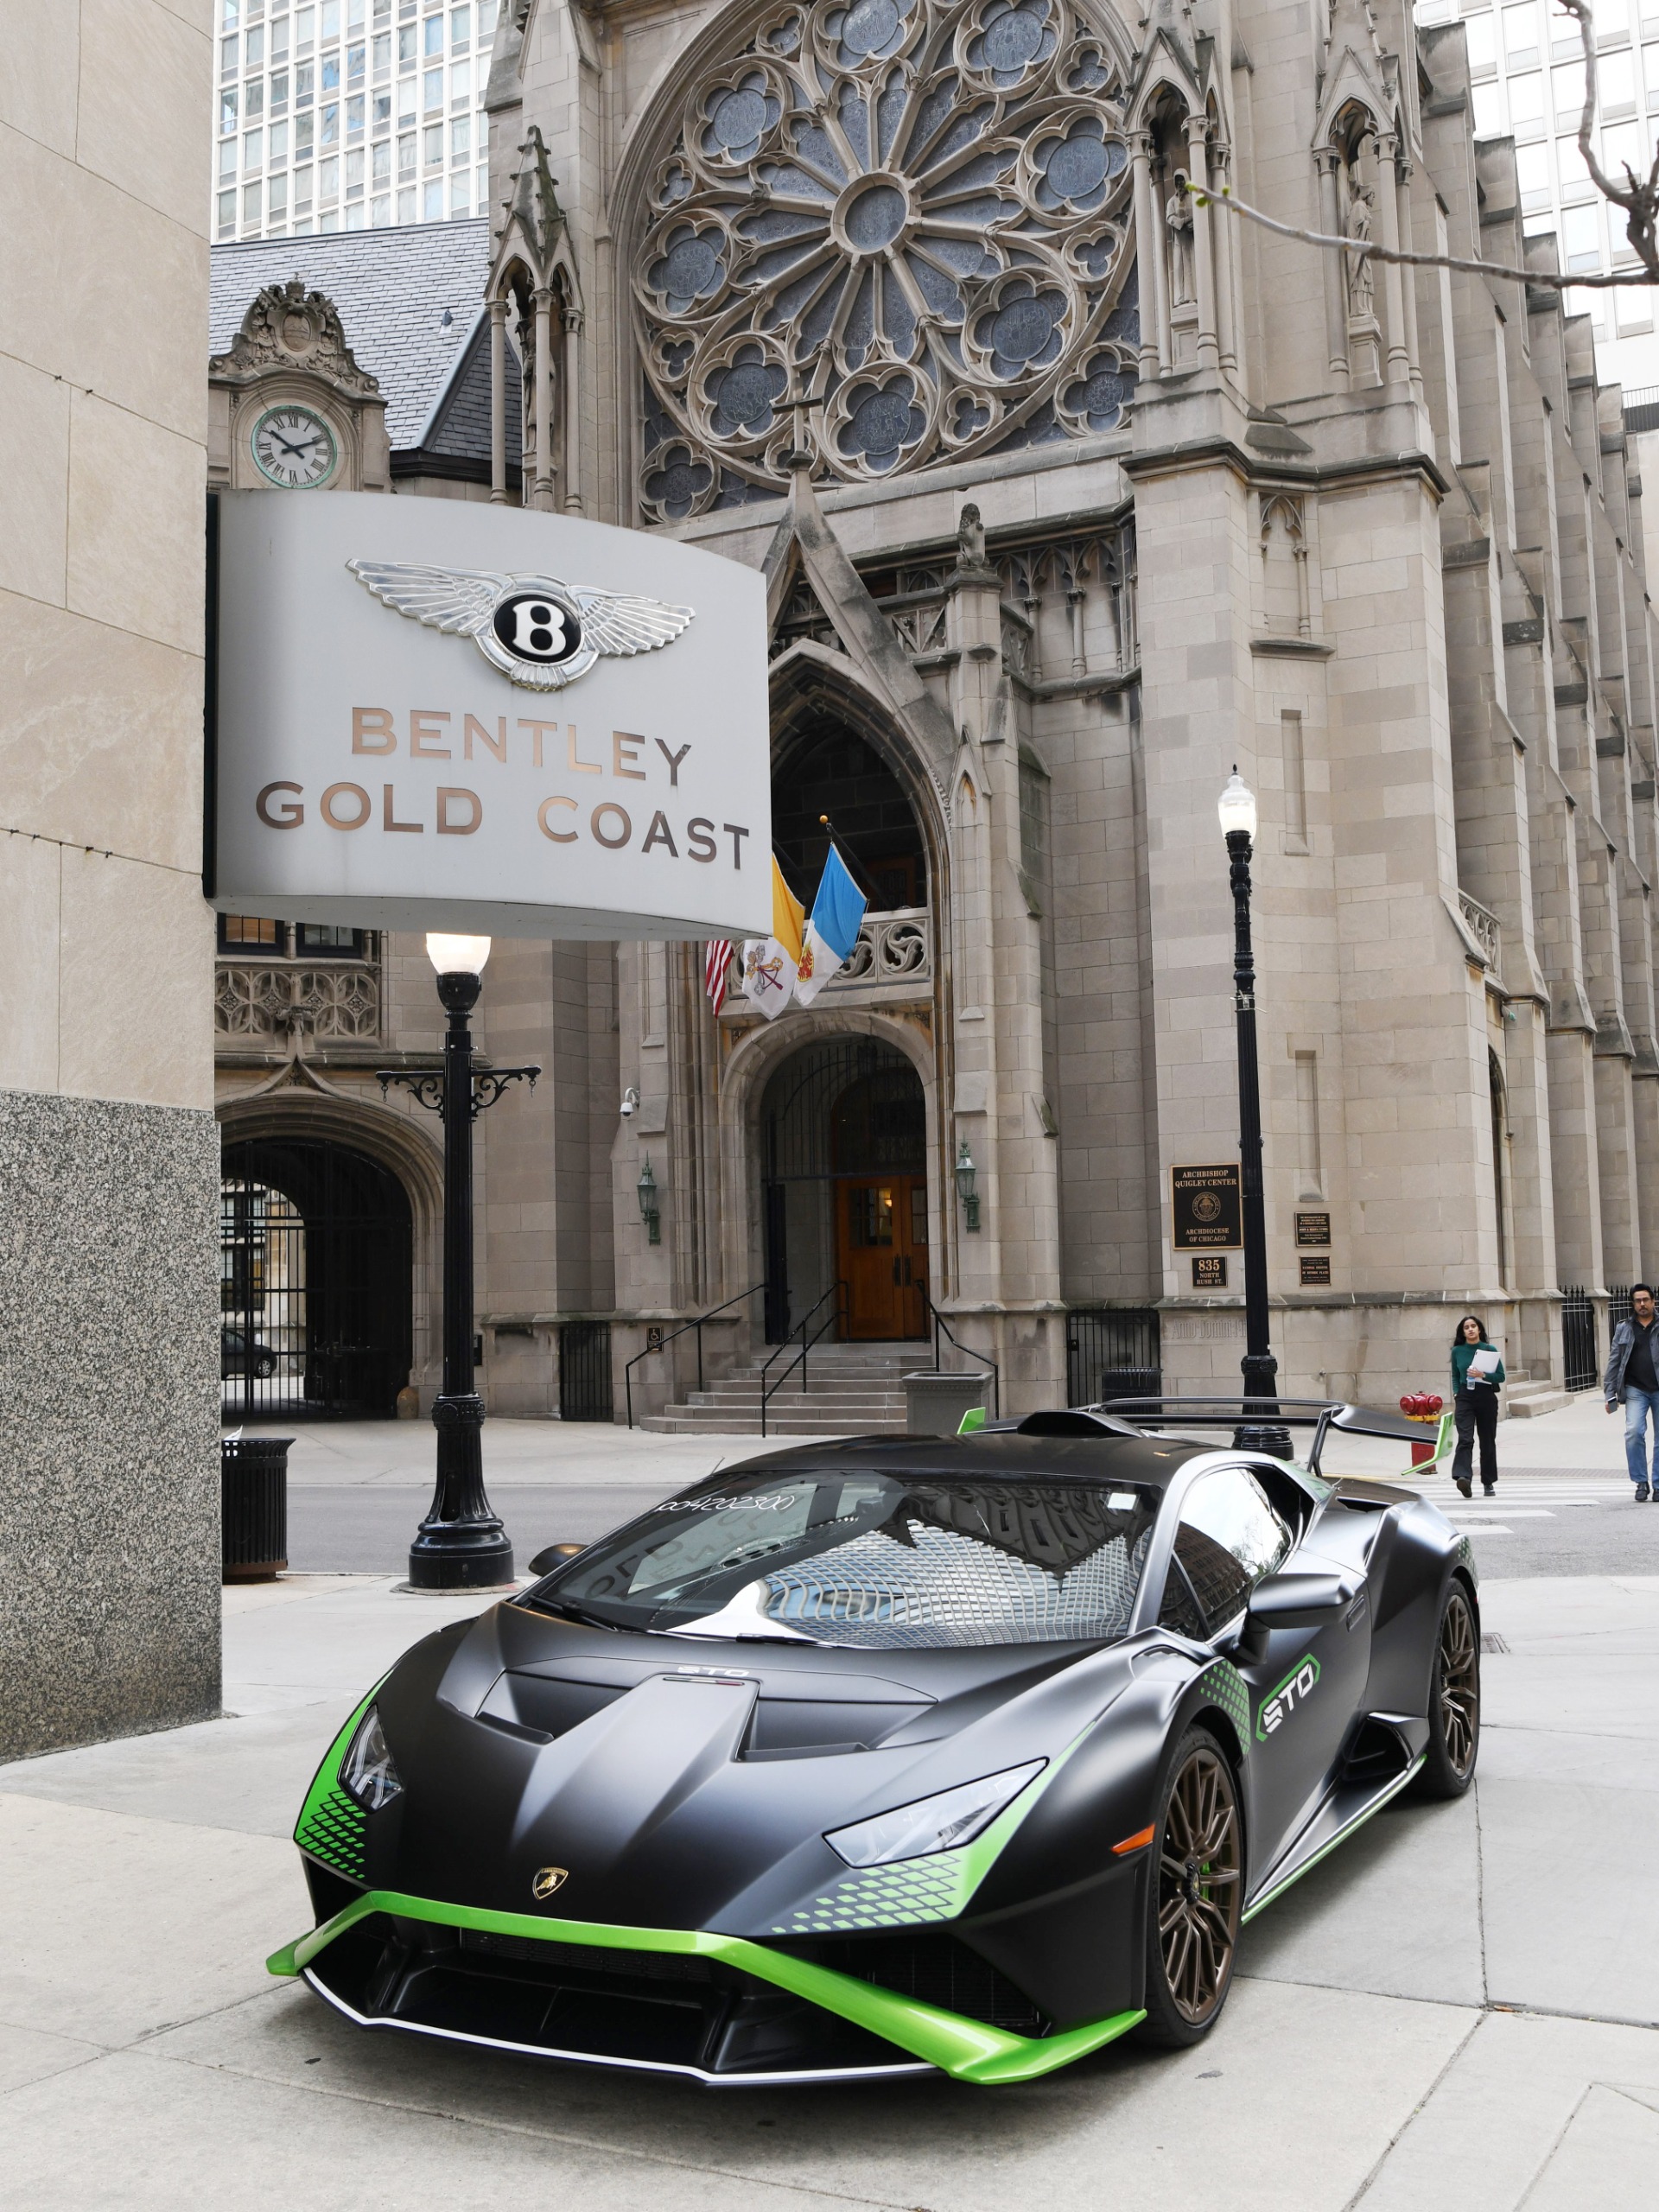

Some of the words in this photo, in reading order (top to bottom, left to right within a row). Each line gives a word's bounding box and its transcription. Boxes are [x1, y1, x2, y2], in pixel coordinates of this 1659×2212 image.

[513, 601, 567, 657] B
[351, 706, 692, 787] BENTLEY
[256, 780, 483, 836] GOLD
[537, 795, 750, 870] COAST
[1182, 1169, 1229, 1179] ARCHBISHOP
[1175, 1179, 1207, 1189] QUIGLEY
[1207, 1178, 1237, 1186] CENTER
[1185, 1227, 1230, 1236] ARCHDIOCESE
[1198, 1259, 1220, 1271] 835
[677, 1665, 751, 1678] STO
[1262, 1663, 1313, 1732] STO
